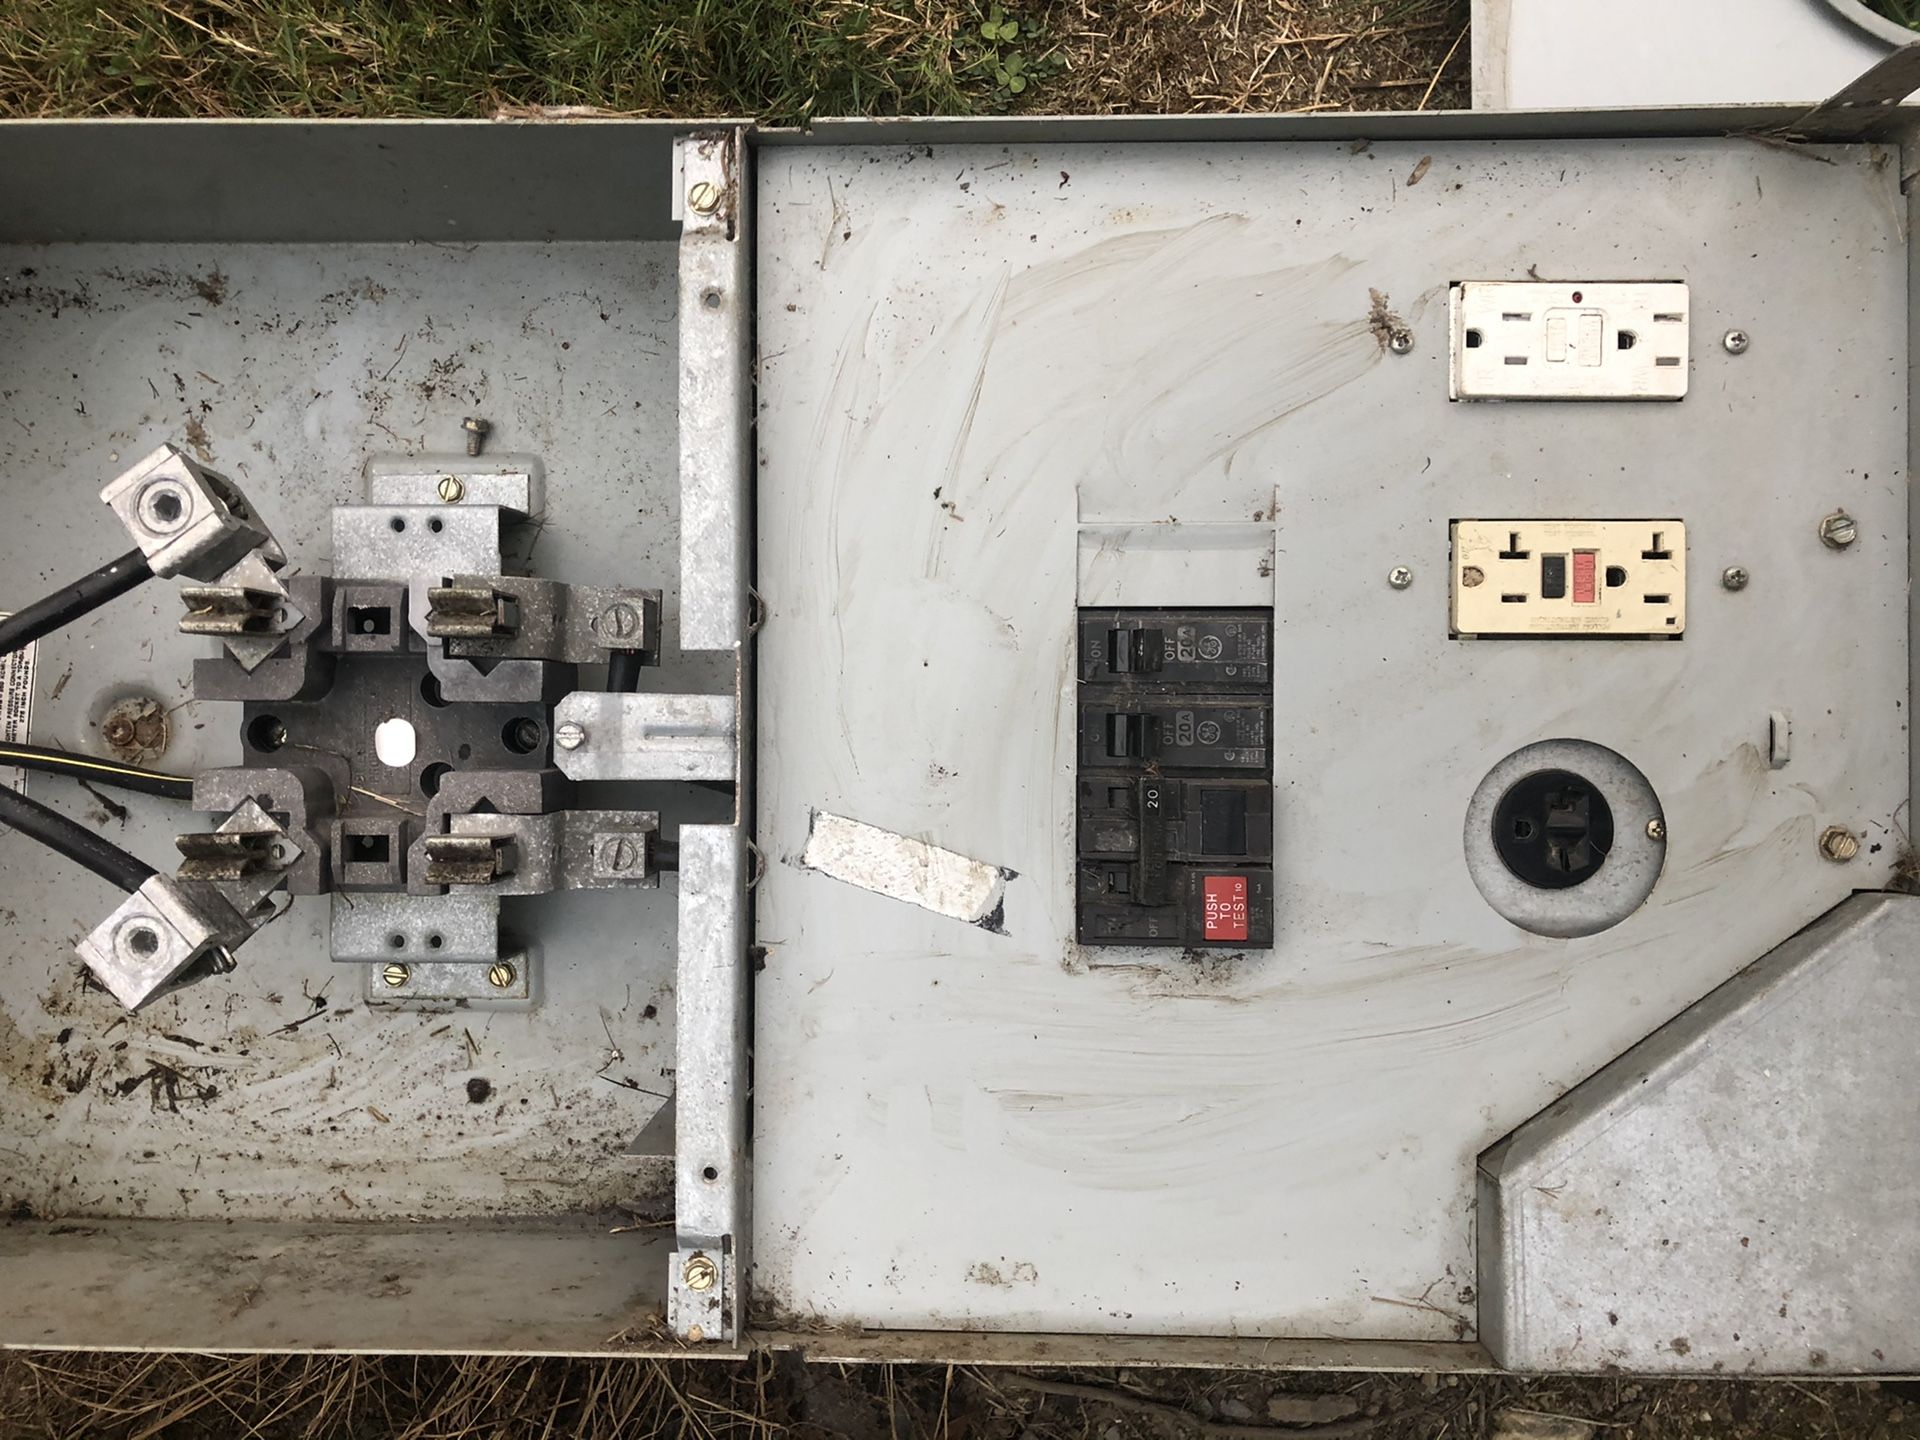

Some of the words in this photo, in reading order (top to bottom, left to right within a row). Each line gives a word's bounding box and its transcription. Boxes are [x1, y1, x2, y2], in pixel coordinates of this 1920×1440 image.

[1090, 640, 1101, 658] ON
[1164, 637, 1175, 661] OFF
[1163, 722, 1174, 745] OFF
[1147, 789, 1159, 809] 20
[1235, 882, 1242, 892] 10
[1206, 893, 1218, 929] PUSH
[1219, 902, 1231, 920] TO
[1232, 894, 1245, 929] TEST
[1148, 918, 1159, 938] OFF
